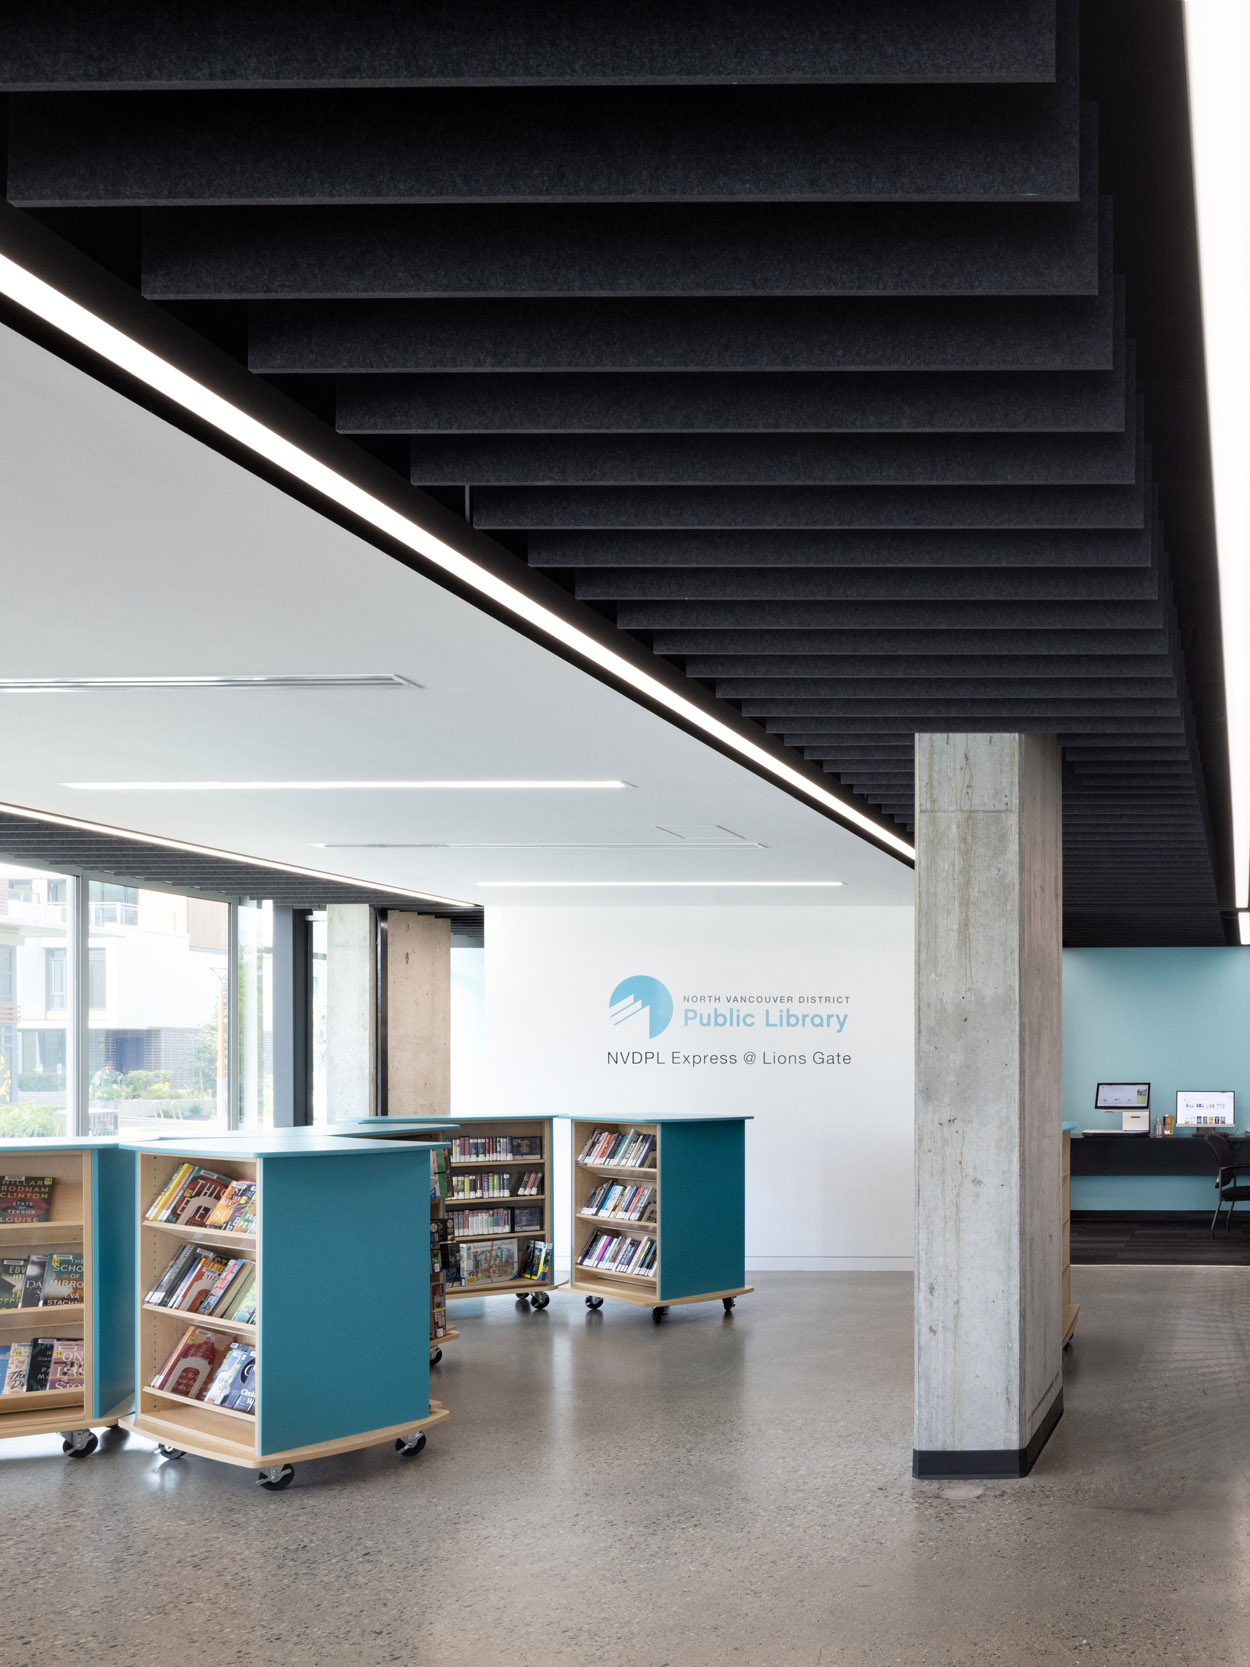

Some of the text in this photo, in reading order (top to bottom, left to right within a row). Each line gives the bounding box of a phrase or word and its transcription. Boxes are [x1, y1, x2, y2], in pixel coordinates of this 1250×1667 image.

[683, 995, 851, 1004] NORTH VANCOUVER DISTRICT
[684, 1008, 849, 1034] Public Library
[607, 1051, 852, 1068] NVDPL Express @ Lions Gate
[53, 1264, 83, 1272] SCHO
[49, 1280, 83, 1288] MIRRO
